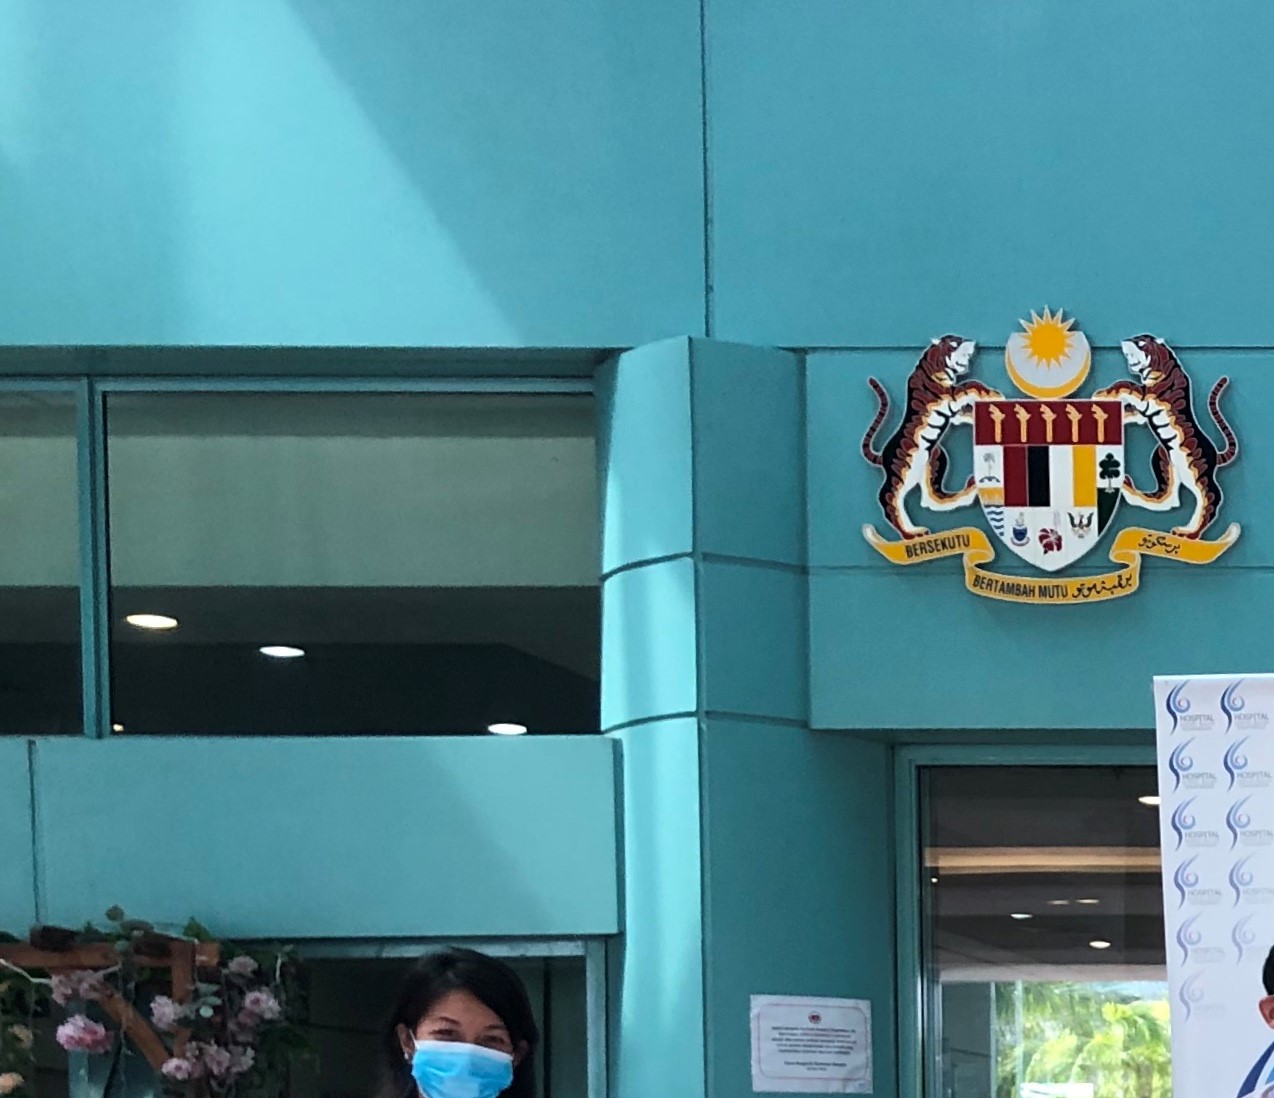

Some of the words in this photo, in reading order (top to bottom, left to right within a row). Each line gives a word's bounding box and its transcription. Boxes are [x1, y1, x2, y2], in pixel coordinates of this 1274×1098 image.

[905, 533, 971, 559] BERSEKUTU
[972, 575, 1036, 599] BERTAMBAH
[1037, 583, 1069, 599] MUTU
